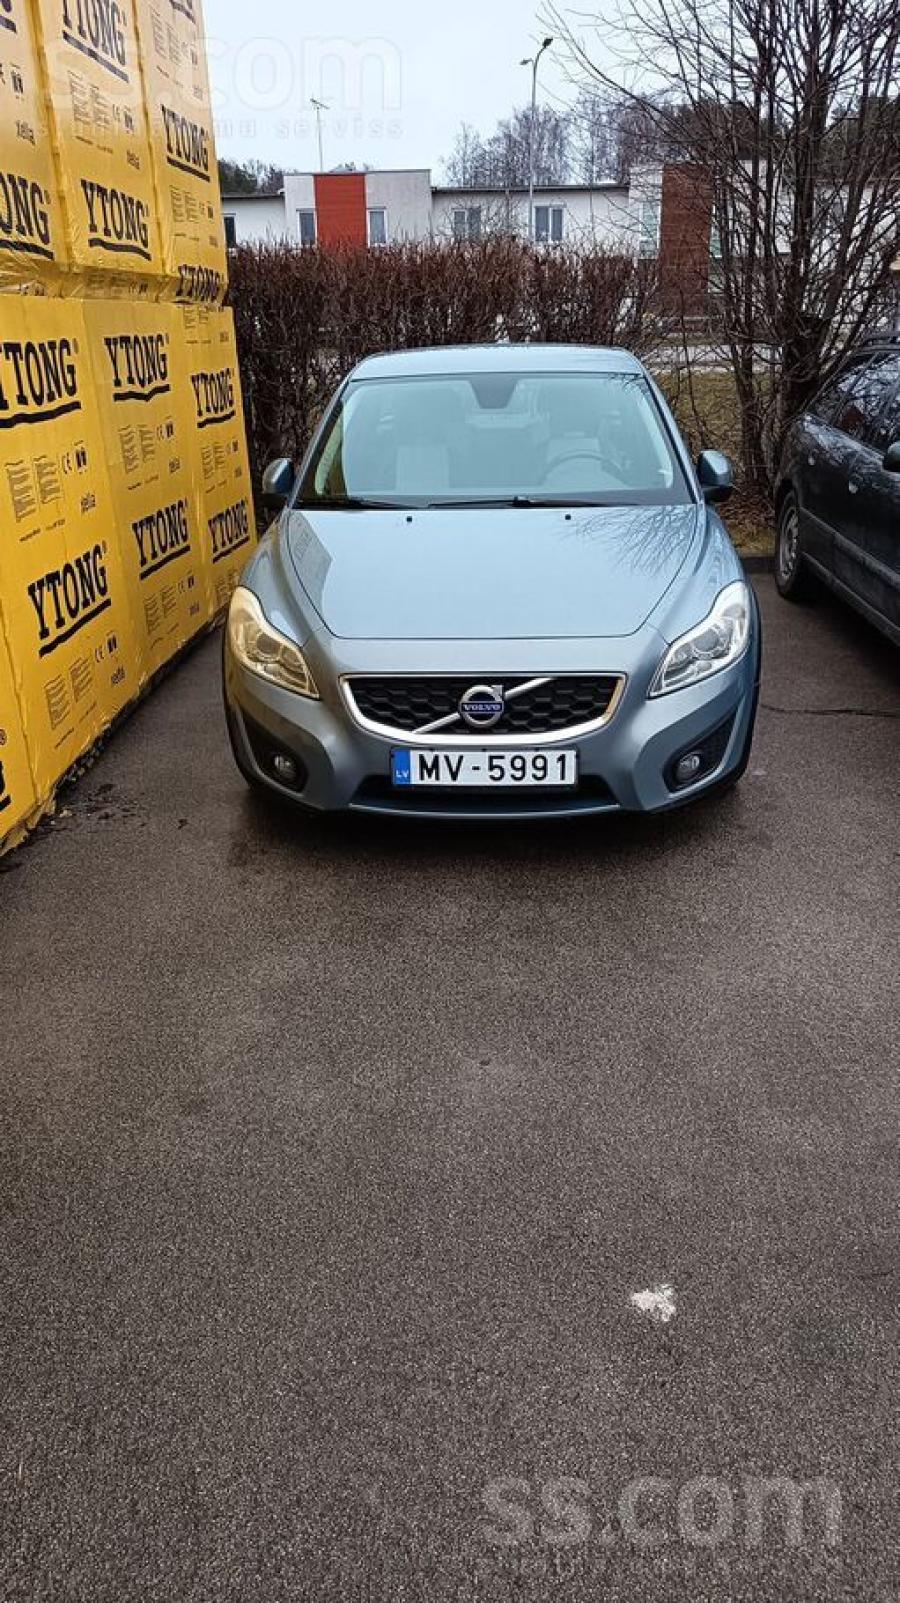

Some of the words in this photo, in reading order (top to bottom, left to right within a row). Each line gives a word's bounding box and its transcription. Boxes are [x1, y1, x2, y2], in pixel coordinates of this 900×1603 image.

[161, 104, 209, 172] YTONG
[80, 178, 149, 248] YTONG
[177, 264, 220, 303] YTONG
[103, 334, 169, 388] YTONG
[191, 367, 235, 417] YTONG
[132, 499, 189, 567] YTONG
[208, 499, 249, 553] YTONG
[28, 544, 108, 640] YTONG
[463, 704, 502, 712] VOLVO
[395, 769, 409, 778] LV
[418, 753, 566, 781] MV-5991
